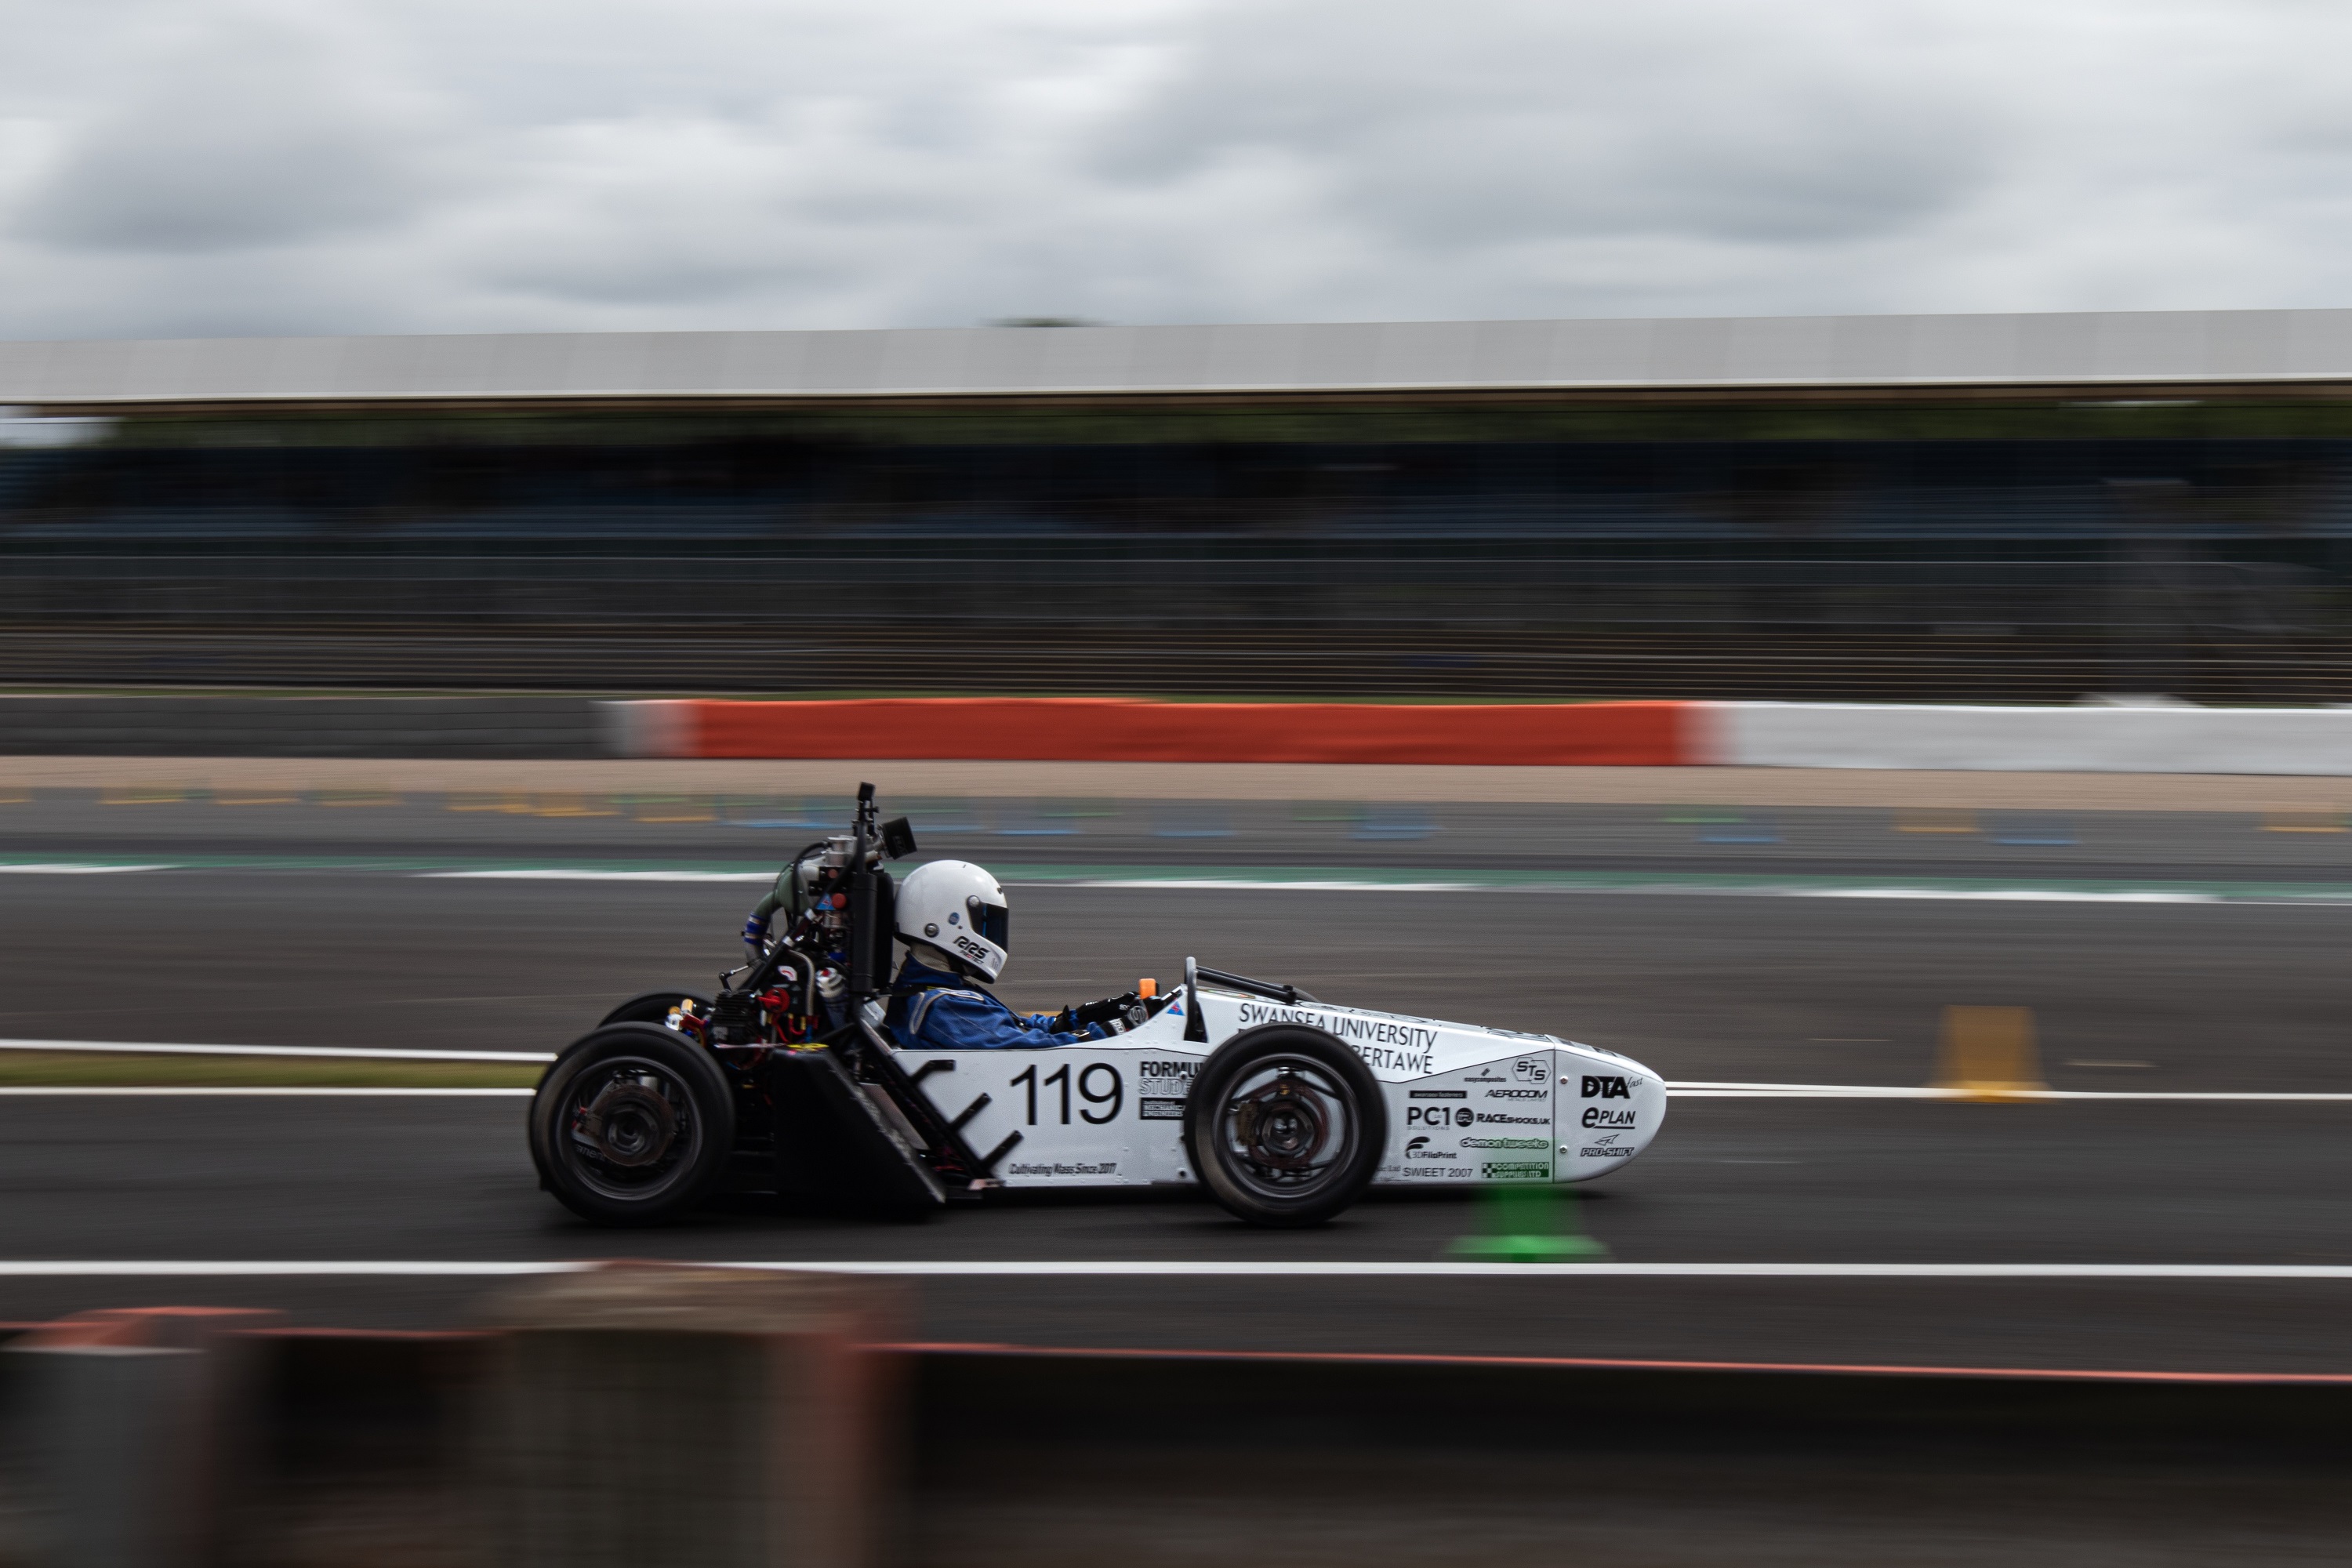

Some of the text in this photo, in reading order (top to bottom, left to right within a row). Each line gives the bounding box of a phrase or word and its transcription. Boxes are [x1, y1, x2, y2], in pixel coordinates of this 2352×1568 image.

[953, 936, 990, 959] RRS
[1239, 1003, 1439, 1054] SWANSEA UNIVERSITY
[1140, 1061, 1203, 1078] FORMU
[1010, 1062, 1123, 1126] 119
[1138, 1077, 1193, 1095] STUDE
[1484, 1089, 1548, 1098] AEROCOM
[1581, 1076, 1631, 1098] DTA
[1407, 1106, 1450, 1126] PC1
[1580, 1147, 1635, 1156] PRO-SHIFT
[1402, 1167, 1473, 1178] SWIEET 2007
